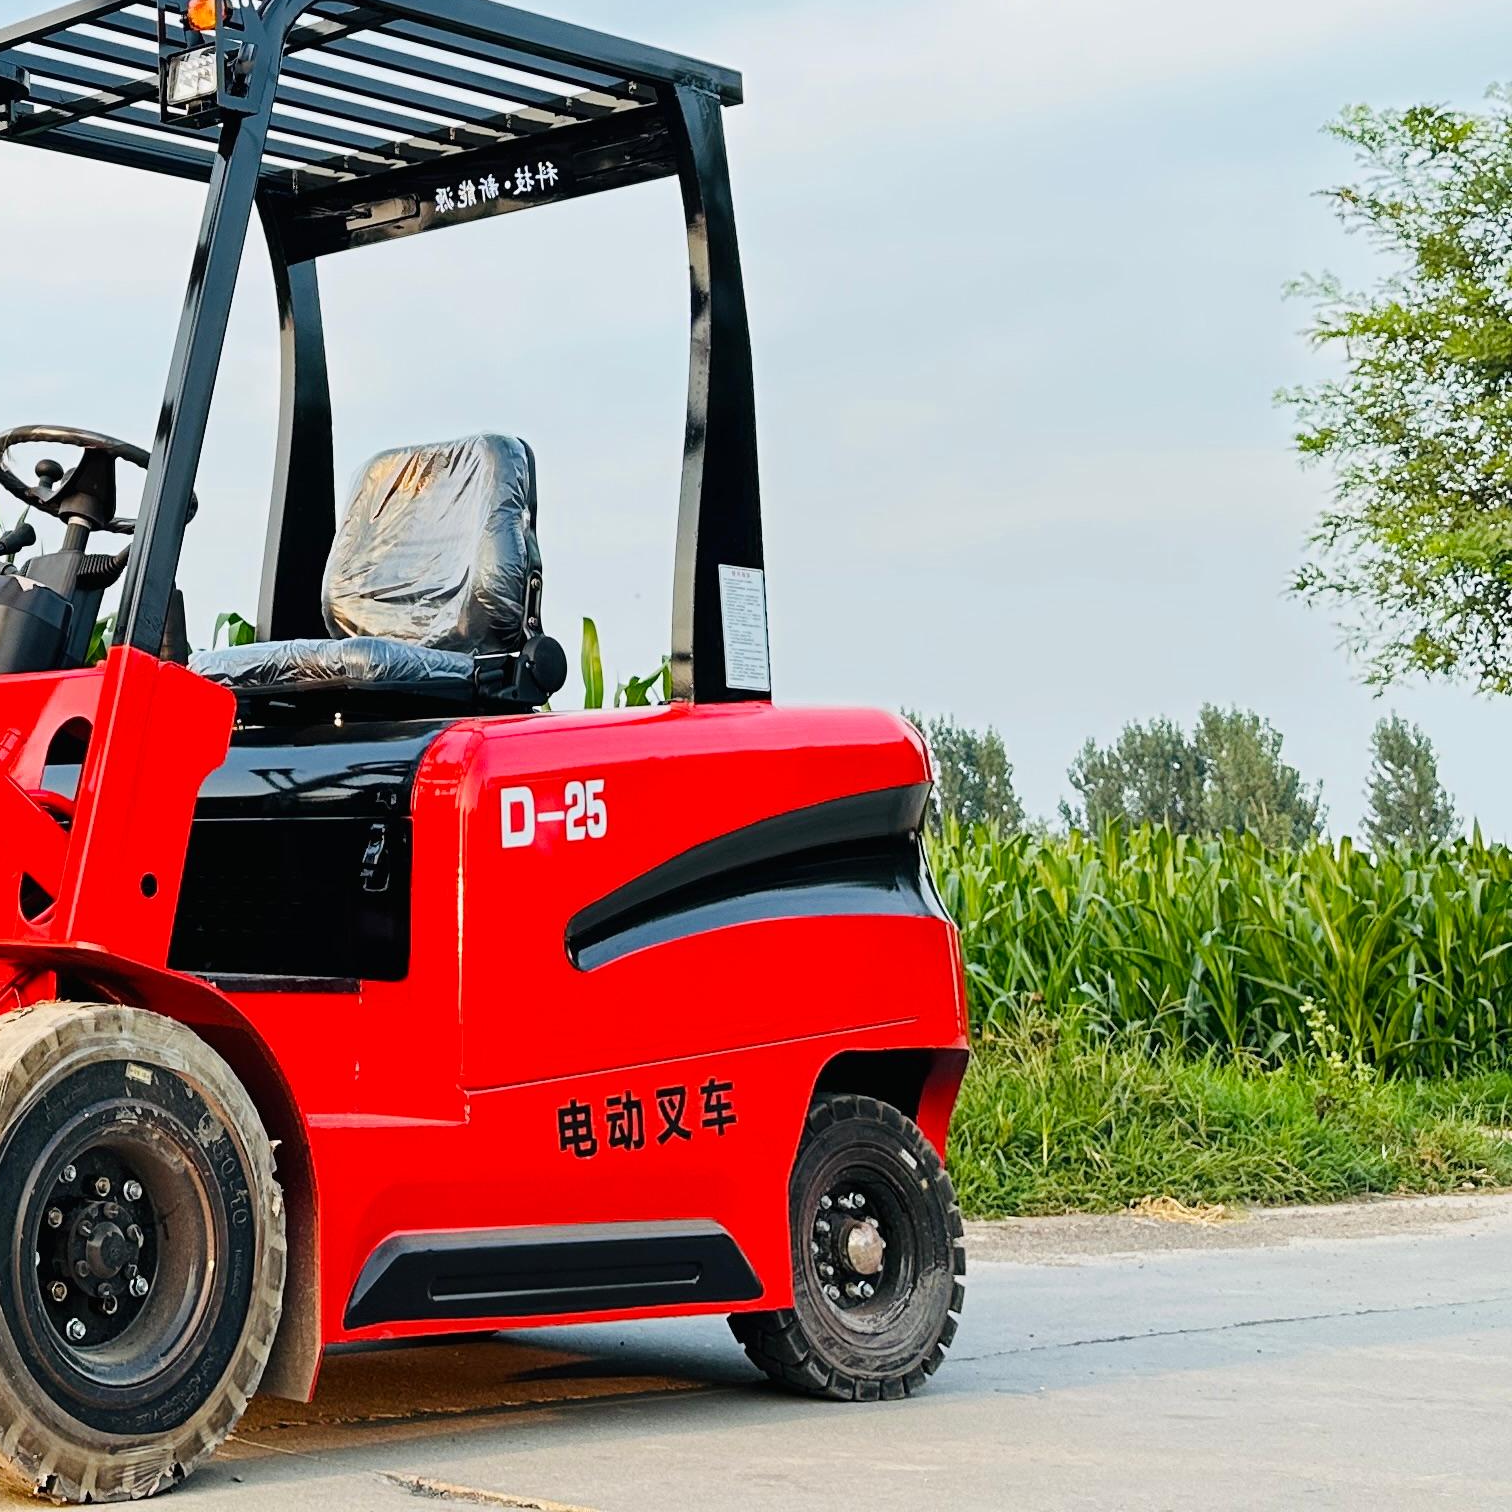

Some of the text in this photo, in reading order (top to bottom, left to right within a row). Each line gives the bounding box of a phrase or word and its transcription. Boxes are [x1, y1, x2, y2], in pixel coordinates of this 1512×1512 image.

[500, 779, 608, 848] D-25
[557, 1078, 737, 1158] 电动叉车
